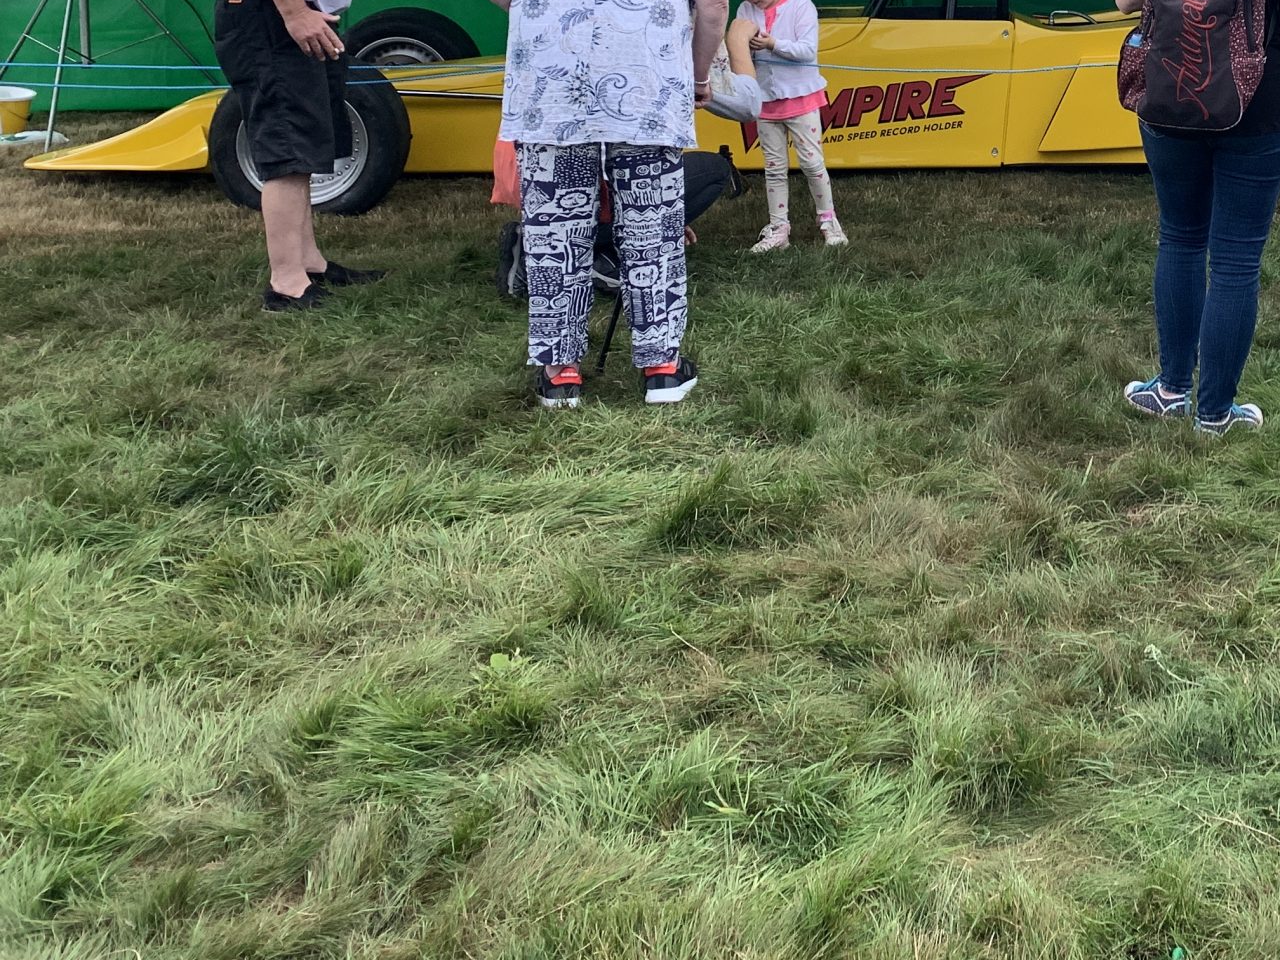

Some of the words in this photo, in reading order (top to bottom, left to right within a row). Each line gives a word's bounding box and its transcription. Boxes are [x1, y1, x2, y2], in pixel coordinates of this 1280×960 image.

[822, 133, 845, 144] AND
[847, 130, 877, 141] SPEED
[879, 125, 921, 138] RECORD
[923, 120, 964, 133] HOLDER
